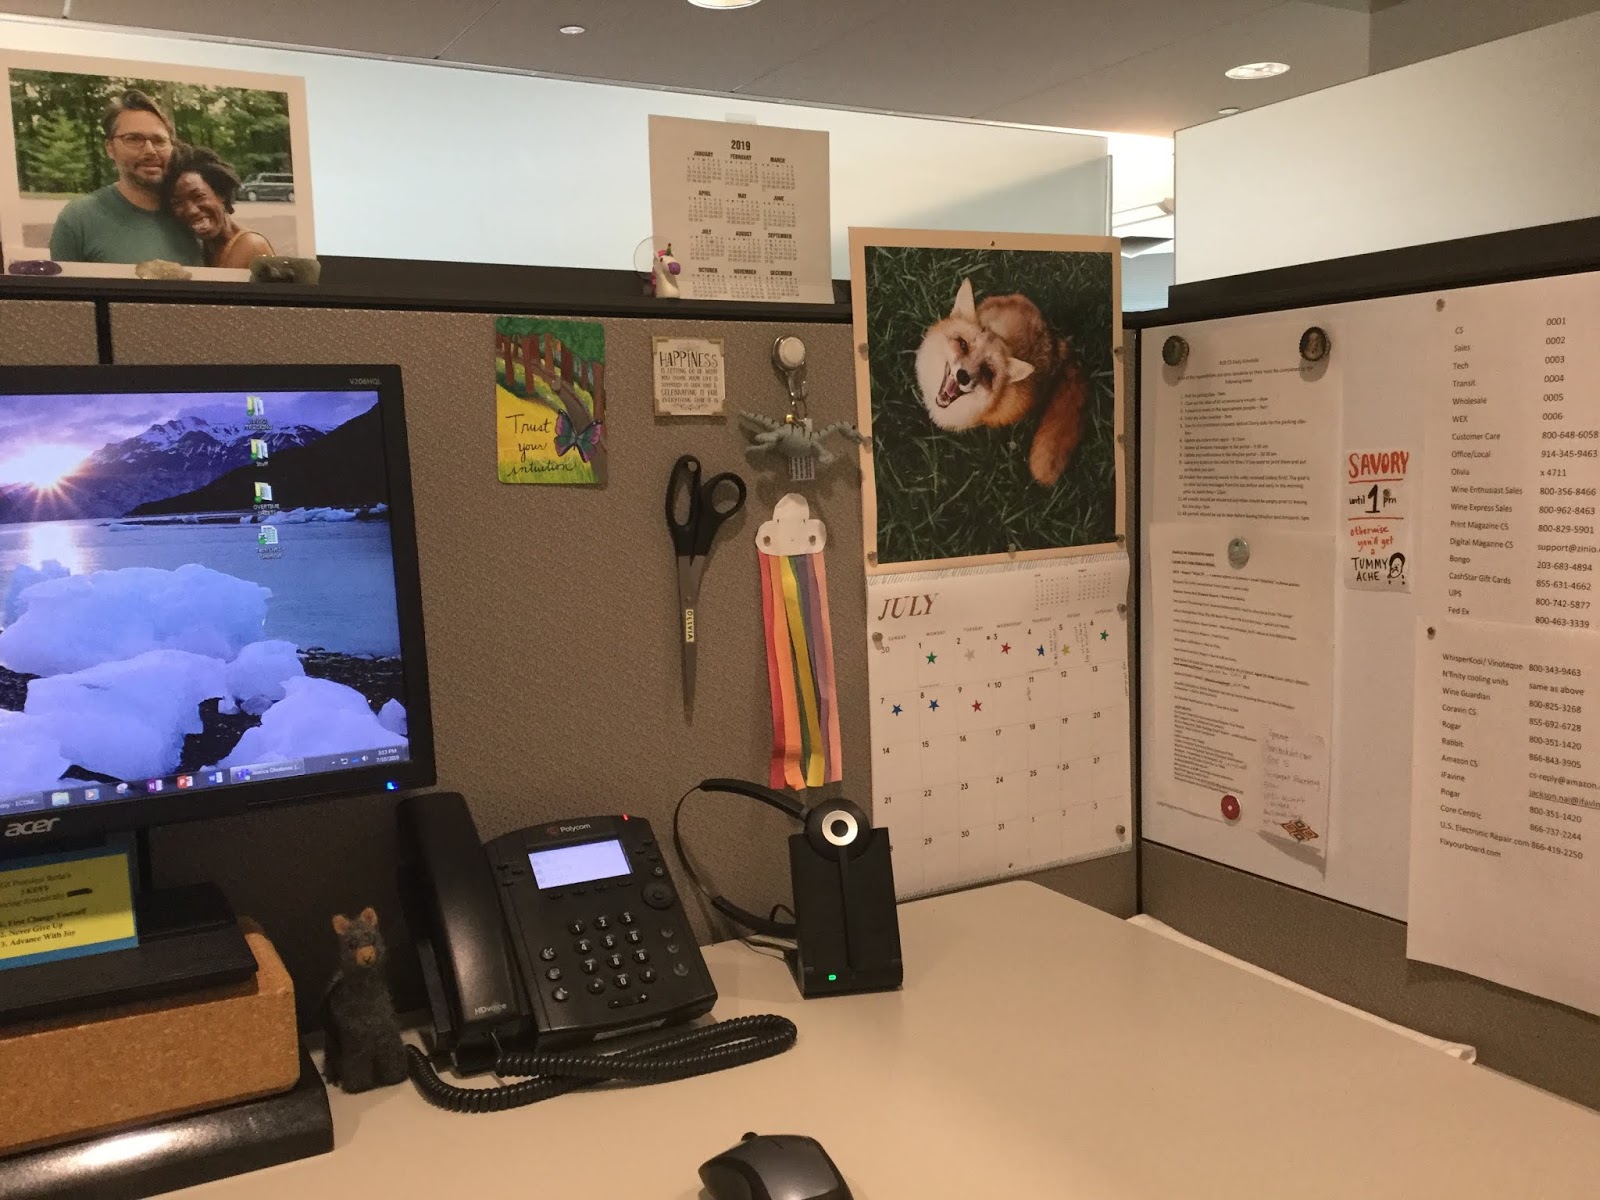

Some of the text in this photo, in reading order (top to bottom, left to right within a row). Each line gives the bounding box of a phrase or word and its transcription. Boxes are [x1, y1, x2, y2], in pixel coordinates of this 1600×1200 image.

[731, 140, 751, 151] 2019
[1546, 337, 1565, 345] 0002
[660, 351, 718, 368] HAPPINESS
[1545, 356, 1565, 364] 0003
[1544, 375, 1564, 383] 0004
[505, 414, 552, 434] Trust
[1542, 431, 1599, 439] 800-648-6058
[518, 443, 547, 462] your
[1541, 450, 1598, 458] 914-345-9463
[507, 460, 577, 477] intuition
[1349, 451, 1410, 479] SAVORY
[1547, 469, 1567, 477] 4711
[1470, 487, 1504, 495] Enthusiast
[1506, 487, 1523, 495] Sales
[1540, 488, 1596, 496] 800-356-8466
[1349, 484, 1380, 513] until 1
[1470, 504, 1494, 512] Express
[1539, 506, 1595, 515] 800-962-8463
[1350, 525, 1389, 537] otherwise
[1468, 522, 1499, 531] Magazine
[1538, 525, 1594, 534] 800-829-5901
[1381, 536, 1394, 549] get
[1450, 538, 1471, 546] Digital
[1472, 540, 1504, 548] Magazine
[1351, 557, 1389, 571] TUMMY
[1450, 555, 1470, 564] Bongo
[1537, 562, 1592, 572] 203-683-4894
[1357, 571, 1380, 582] ACHE
[1449, 573, 1477, 582] CashStar
[1492, 576, 1511, 584] Cards
[1536, 580, 1591, 591] 855-631-4662
[878, 593, 940, 621] JULY
[1536, 598, 1591, 609] 800-742-5877
[1535, 617, 1590, 628] 800-463-3339
[1529, 664, 1581, 677] 800-343-9463
[1467, 675, 1491, 685] cooling
[1443, 688, 1491, 700] Wine Guardian
[1529, 683, 1548, 691] same
[1561, 687, 1585, 696] above
[1442, 704, 1467, 714] Coravin
[1529, 700, 1582, 713] 800-825-3268
[1442, 721, 1461, 730] Rogar
[1529, 718, 1581, 732] 855-692-6728
[1442, 738, 1463, 747] Rabbit
[1529, 736, 1582, 750] 800-351-1420
[1062, 763, 1069, 771] 26
[1441, 755, 1478, 768] Amazon CS
[1529, 754, 1581, 769] 866-843-3905
[1441, 788, 1460, 798] Rogar
[1441, 805, 1482, 819] Core Centric
[1529, 807, 1582, 823] 800-351-1420
[5, 818, 60, 837] acer
[560, 823, 591, 833] Polycom
[1530, 824, 1582, 841] 866-737-2244
[961, 830, 970, 838] 30
[1440, 822, 1583, 860] U.S. Electronic 866-419-2250
[28, 914, 54, 924] Change
[57, 908, 87, 918] Yourself
[625, 915, 631, 923] 3
[9, 922, 63, 936] Never Give Up
[11, 936, 42, 947] Advance
[44, 932, 62, 940] With
[587, 963, 592, 971] 7
[620, 977, 627, 985] 0
